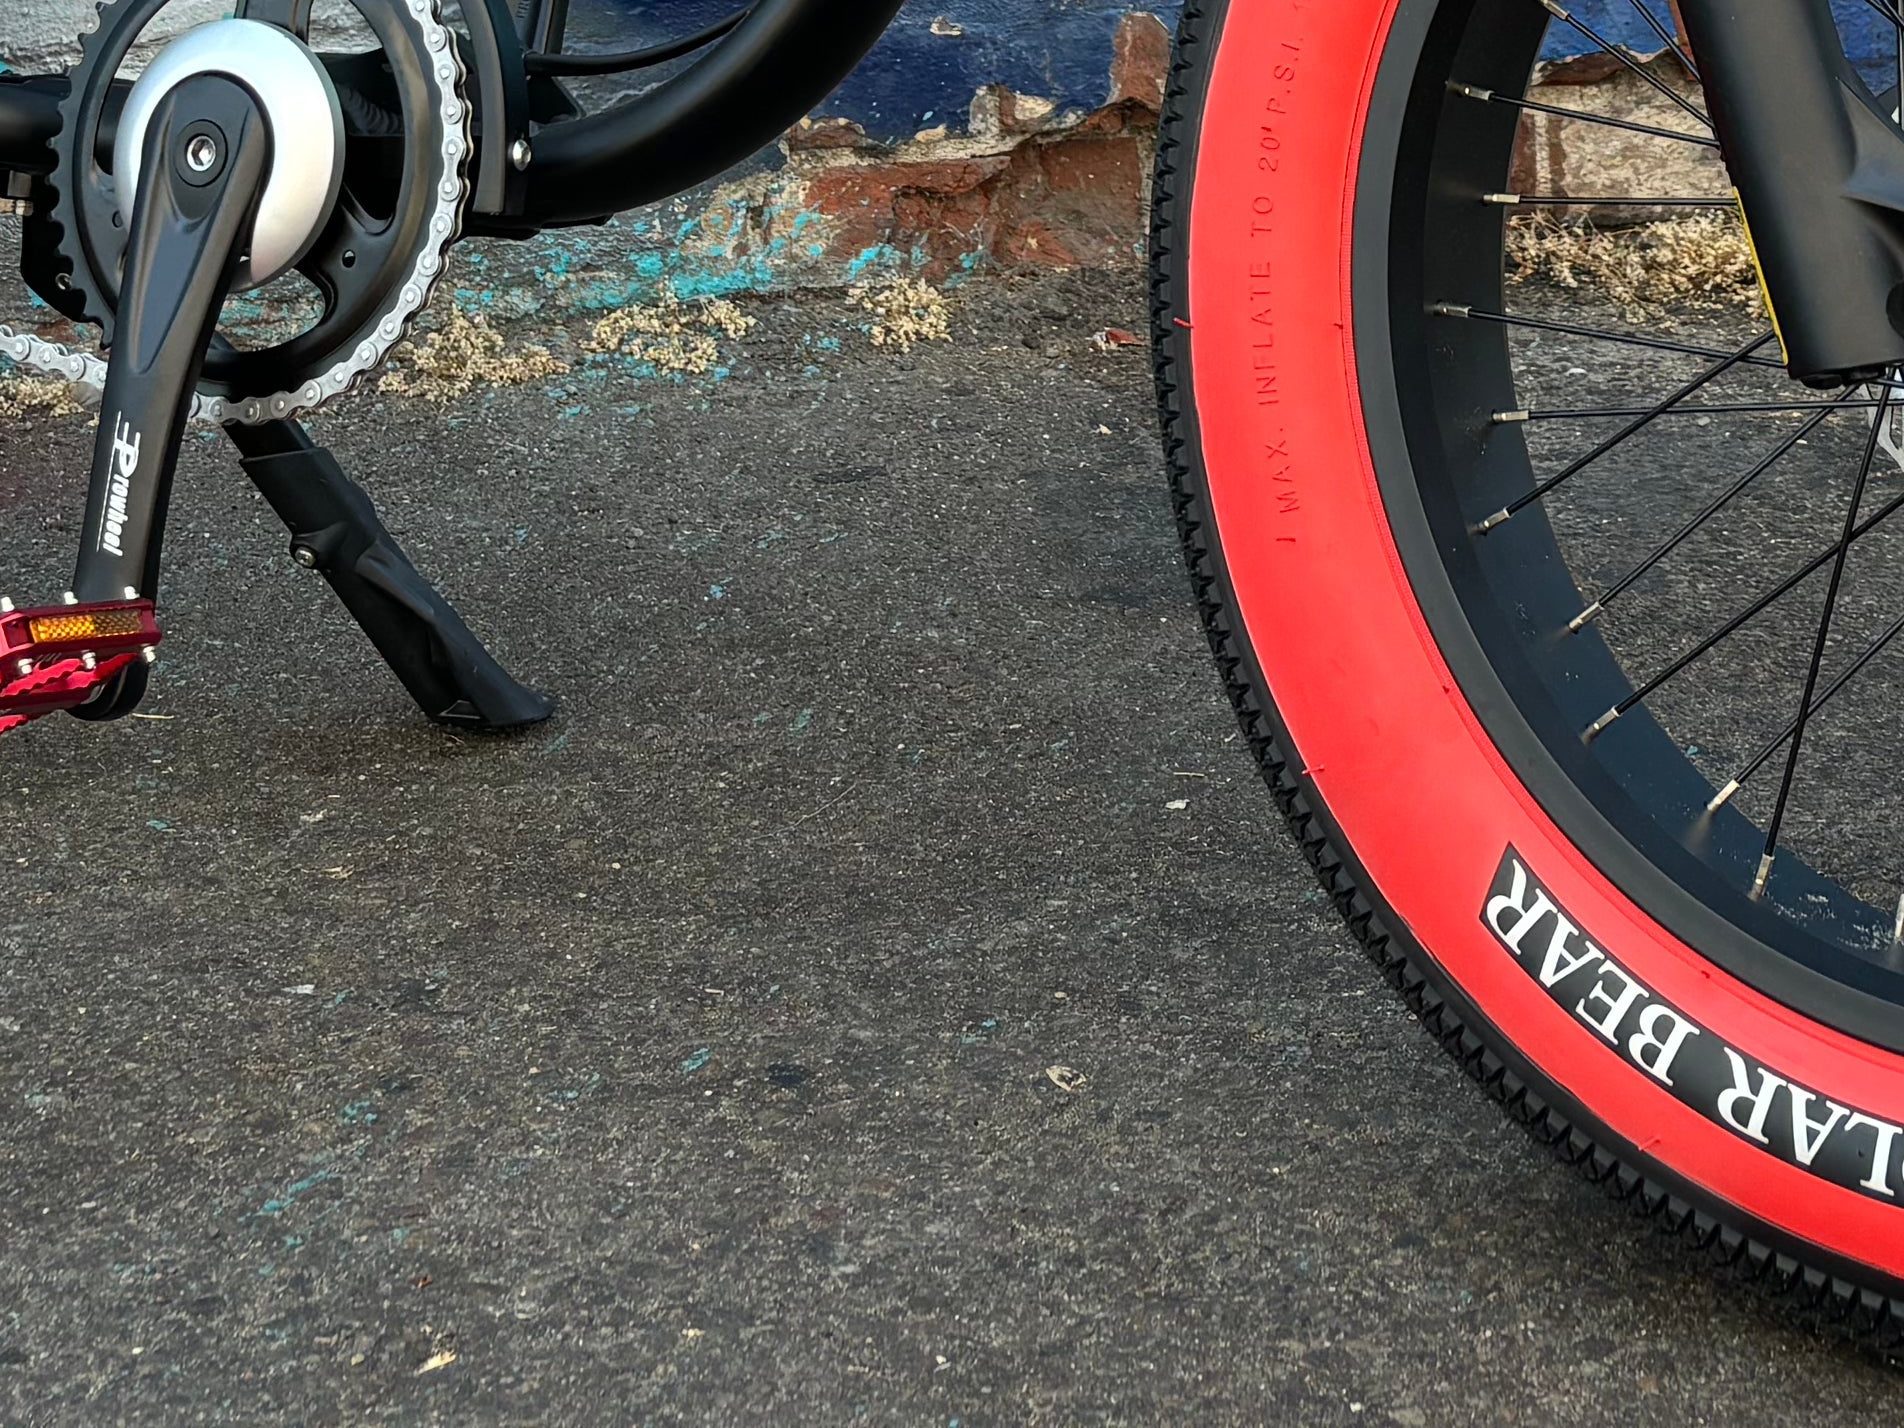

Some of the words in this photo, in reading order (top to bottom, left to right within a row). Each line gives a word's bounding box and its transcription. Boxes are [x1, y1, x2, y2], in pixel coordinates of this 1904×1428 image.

[1250, 196, 1275, 238] TO
[1249, 261, 1280, 407] INFLATE
[101, 419, 142, 558] Prowheel
[1264, 426, 1301, 515] MAX.
[1487, 859, 1700, 1087] BEAR
